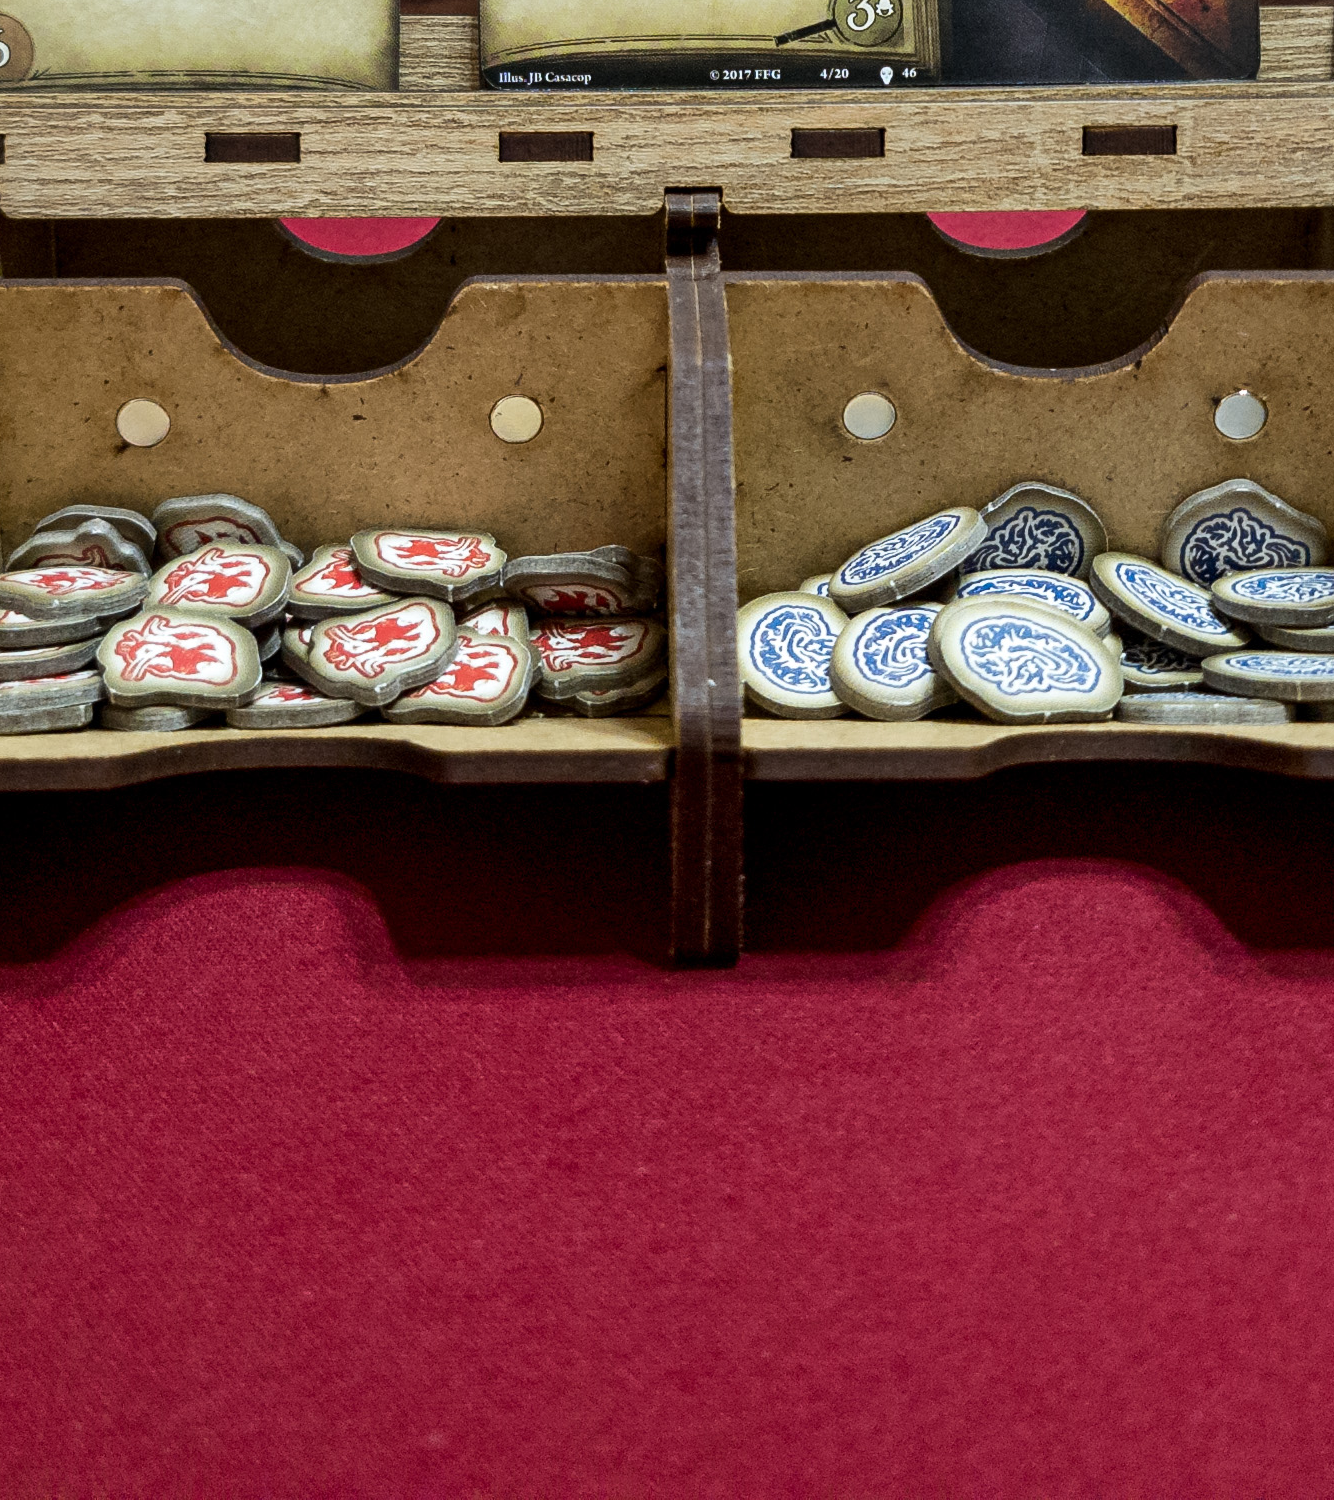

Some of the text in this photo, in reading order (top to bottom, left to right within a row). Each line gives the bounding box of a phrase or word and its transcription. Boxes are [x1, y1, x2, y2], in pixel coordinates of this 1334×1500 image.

[527, 71, 543, 86] JB
[545, 71, 593, 85] Casacop
[722, 69, 752, 81] 2017
[754, 69, 782, 81] FFG
[819, 68, 850, 80] 4/20
[901, 67, 917, 79] 46
